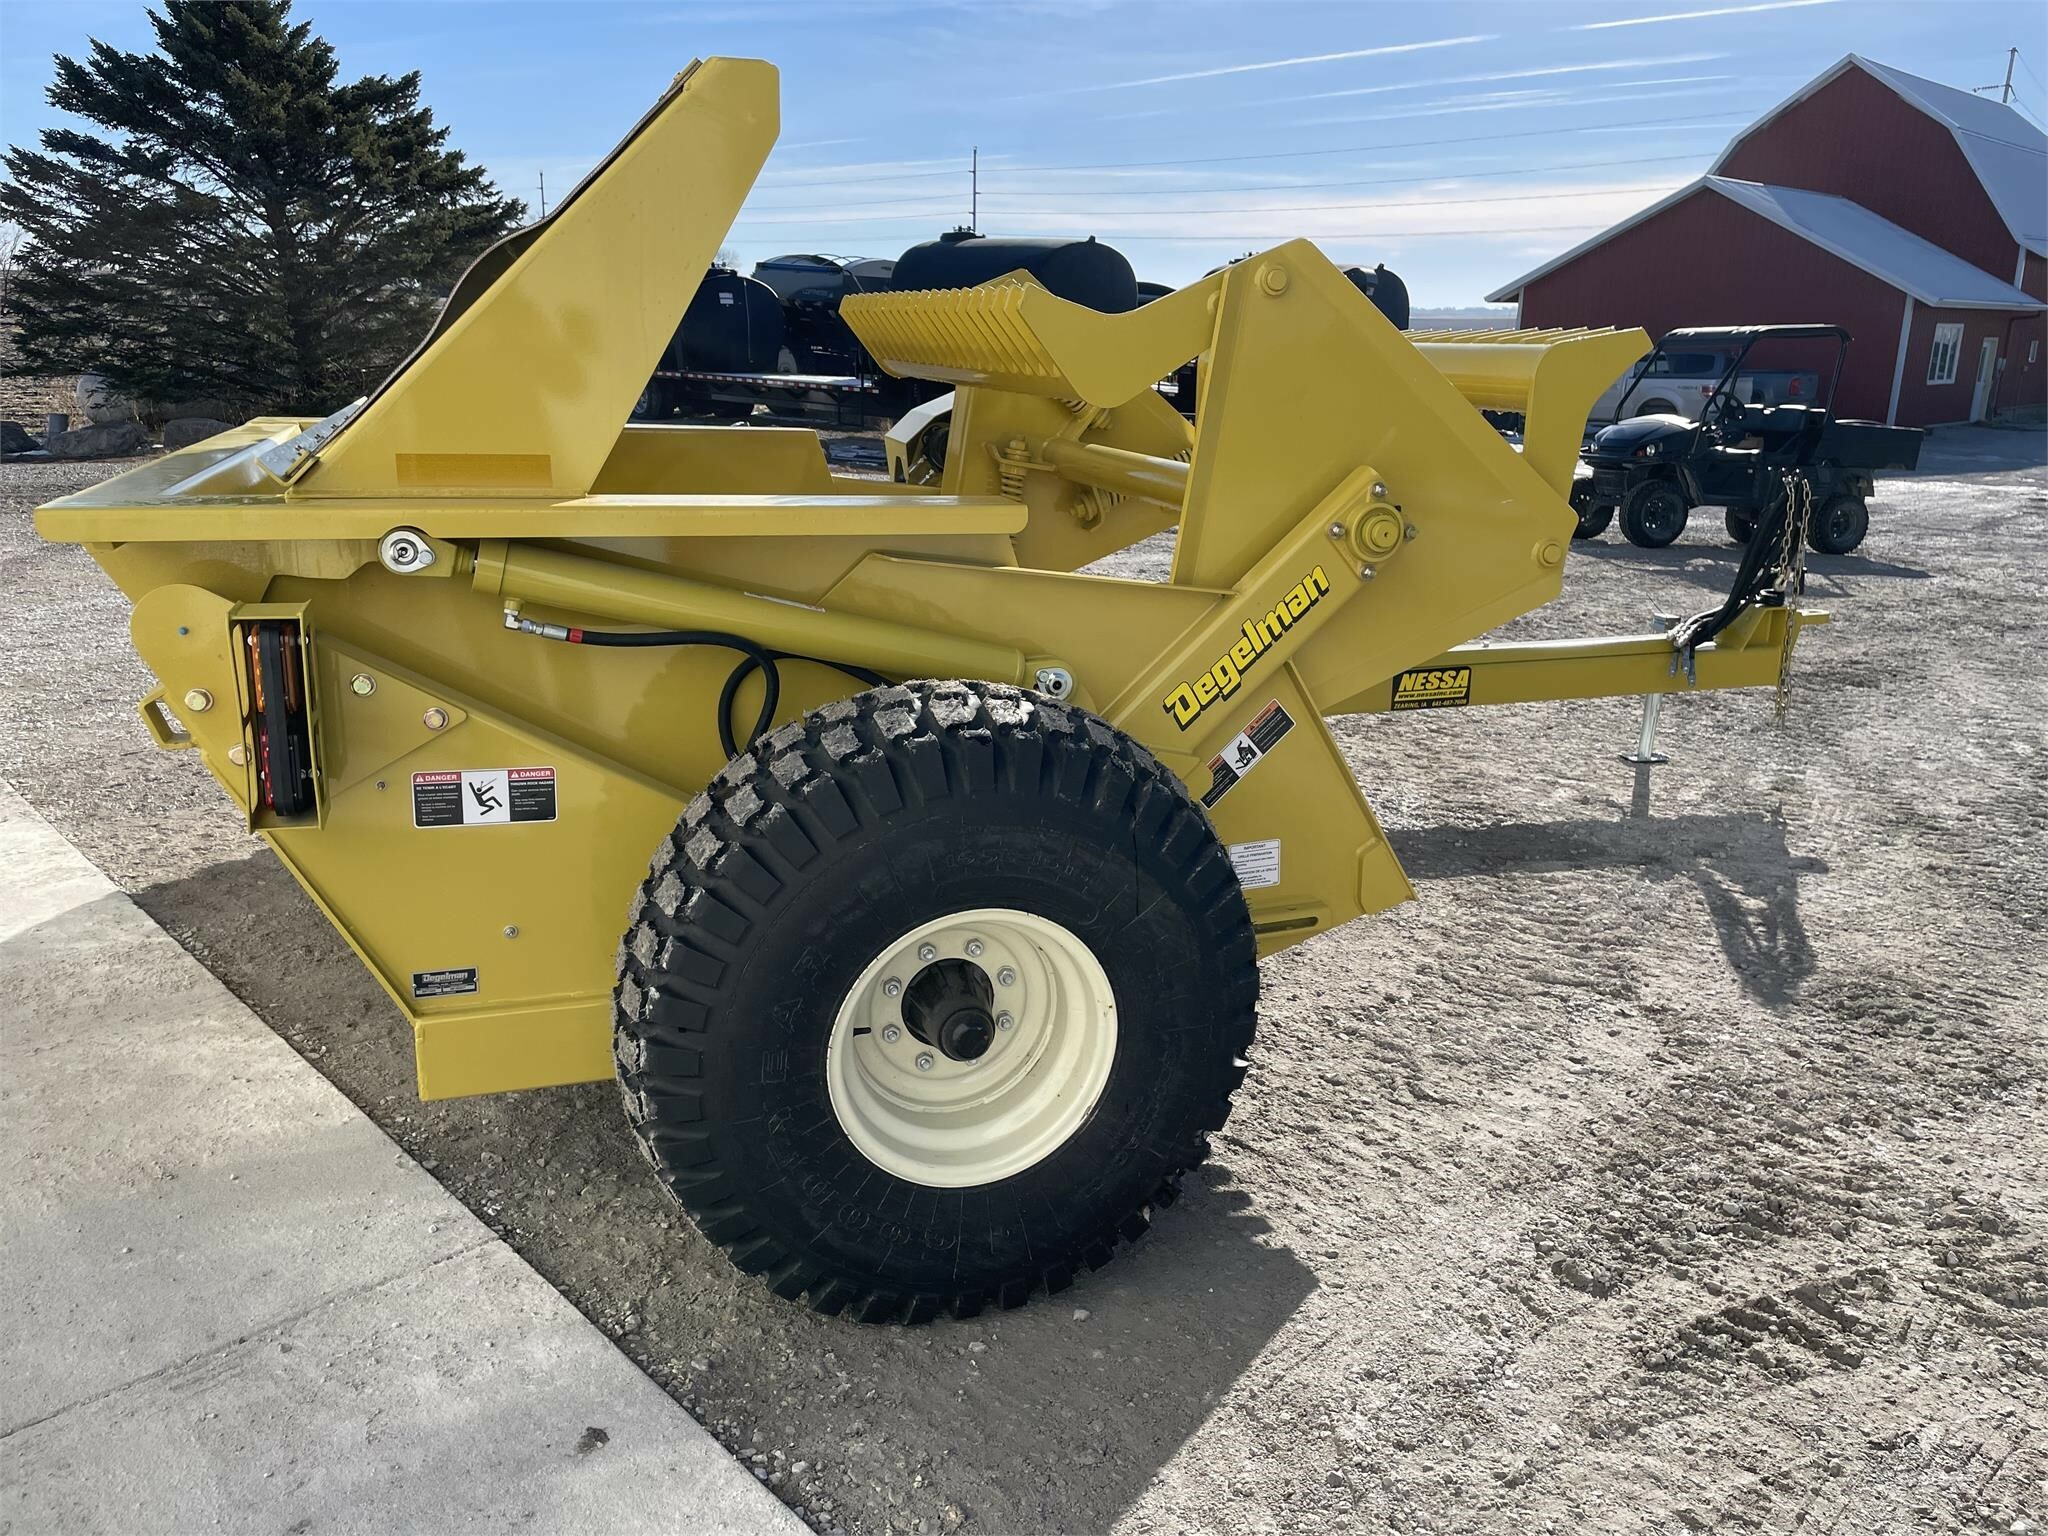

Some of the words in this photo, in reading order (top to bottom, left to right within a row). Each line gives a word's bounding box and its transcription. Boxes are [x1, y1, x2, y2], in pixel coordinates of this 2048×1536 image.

[1162, 564, 1331, 732] Degelman
[1398, 669, 1470, 691] NESSA
[425, 774, 458, 782] DANGER
[520, 770, 551, 778] DANGER
[422, 972, 468, 982] Degelman
